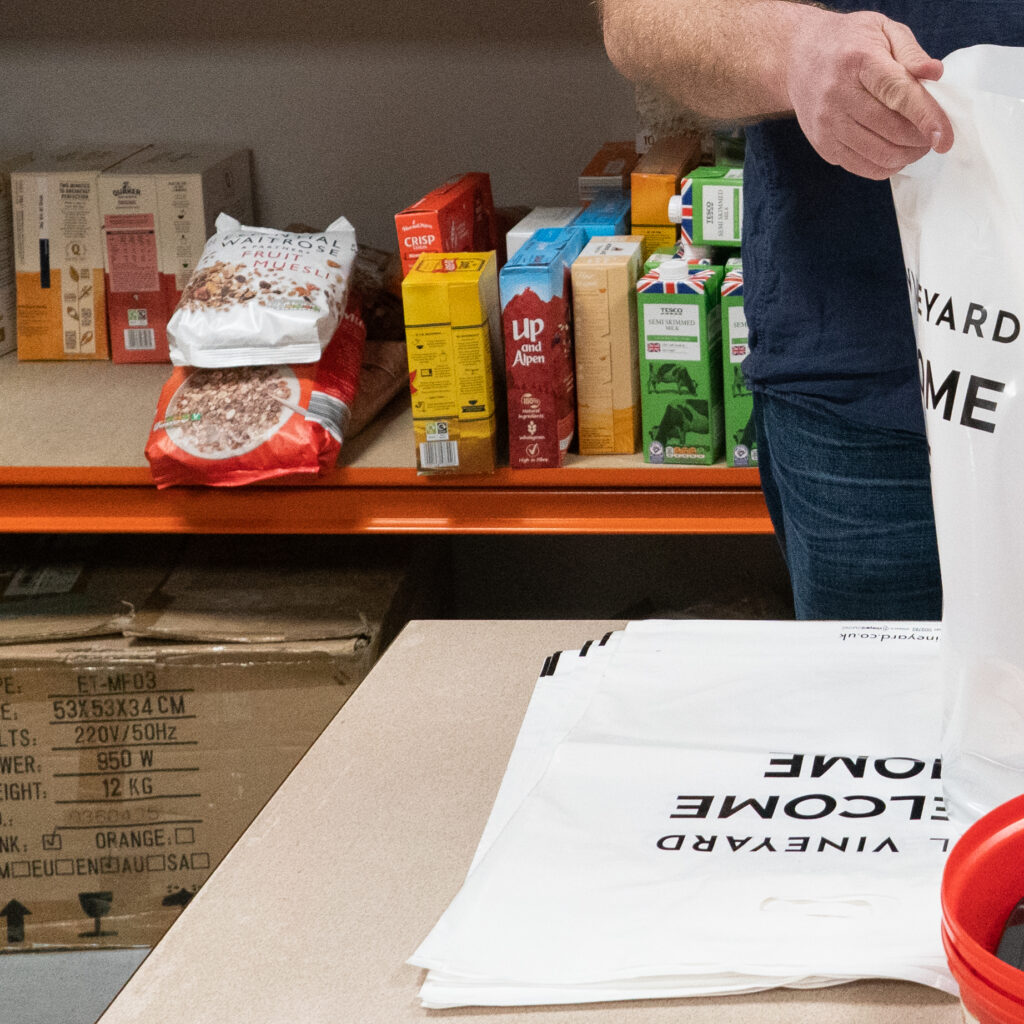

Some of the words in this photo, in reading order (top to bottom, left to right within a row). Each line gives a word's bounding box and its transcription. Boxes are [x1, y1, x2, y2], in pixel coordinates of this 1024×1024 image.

[222, 236, 339, 256] WAITROSE
[404, 234, 436, 248] CRISP
[242, 251, 304, 261] FRUIT
[253, 260, 330, 279] MUESLI
[521, 341, 542, 352] and
[512, 350, 544, 367] Alpen
[77, 673, 157, 694] ET-MF03
[53, 697, 152, 720] 53X53X34
[157, 695, 186, 715] CM
[75, 724, 178, 745] 220V/50Hz
[140, 749, 155, 767] W
[103, 778, 122, 798] 12
[129, 777, 154, 797] KG
[95, 829, 173, 850] ORANGE:
[656, 834, 899, 853] VINEYARD
[32, 859, 55, 877] EU
[76, 857, 98, 876] EN
[122, 855, 145, 874] AU
[167, 854, 192, 871] SA
